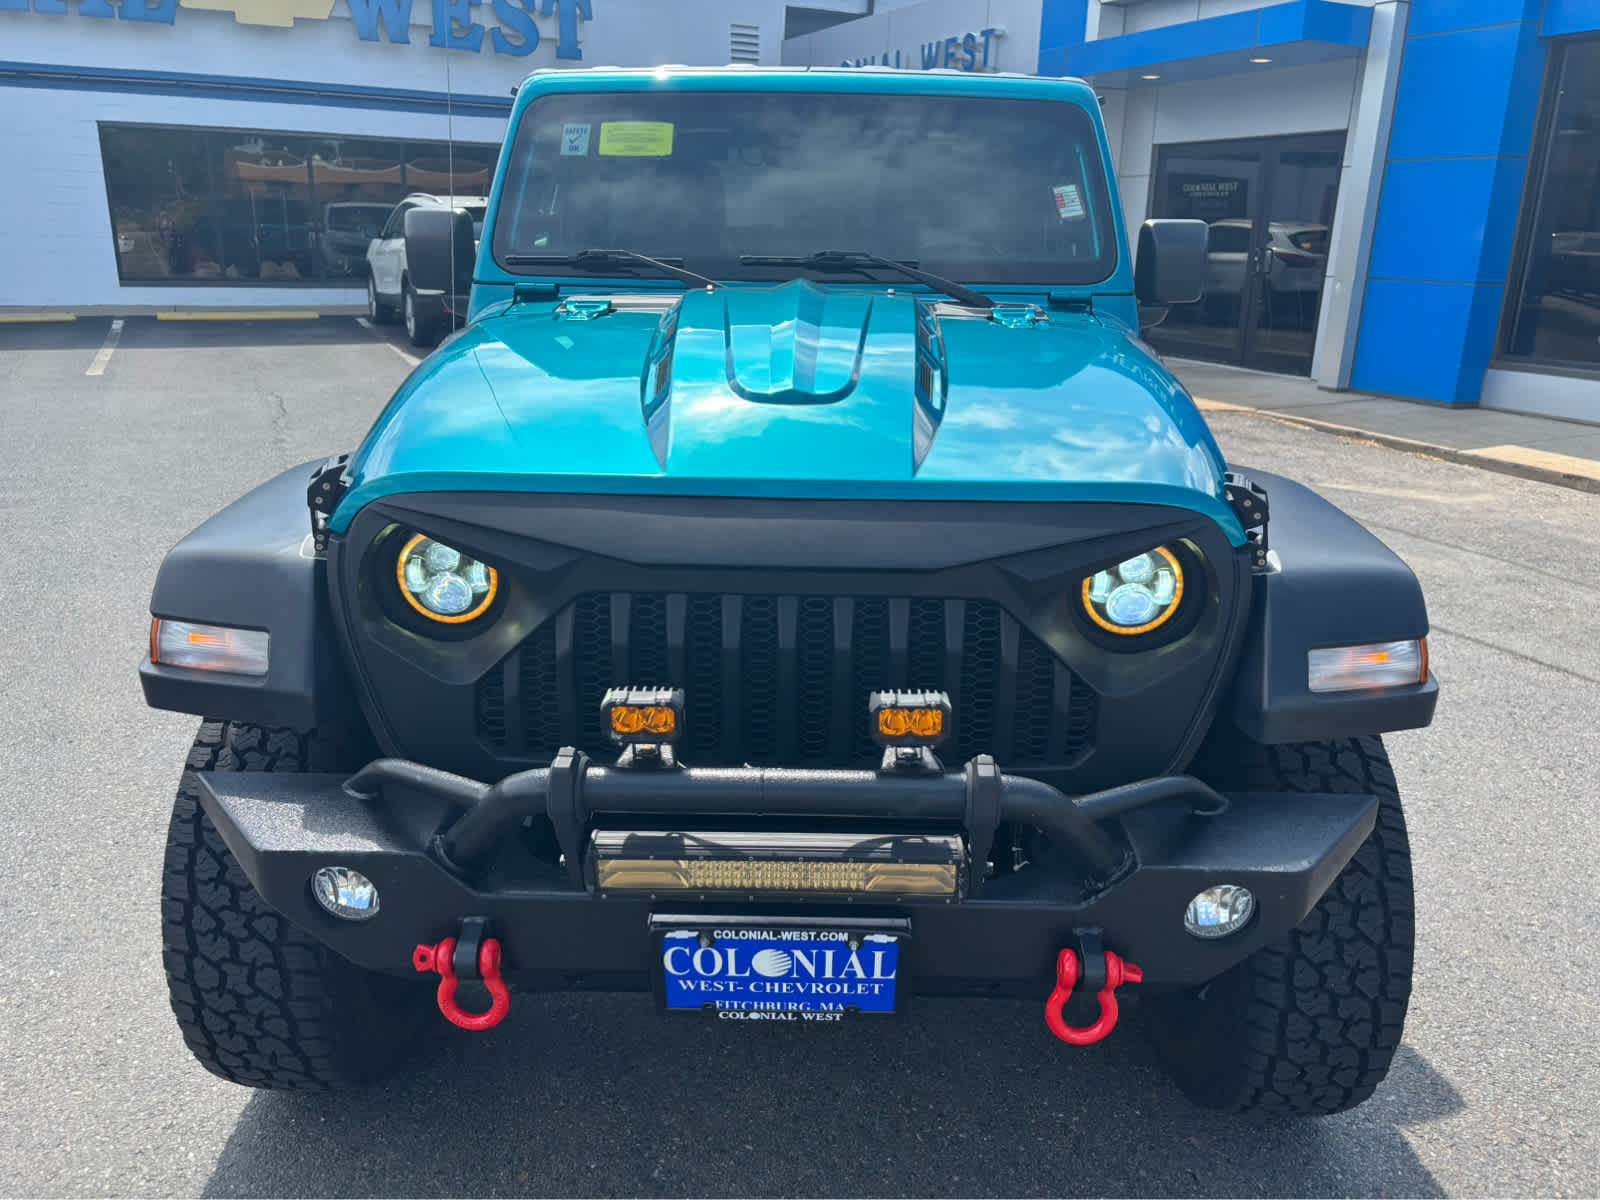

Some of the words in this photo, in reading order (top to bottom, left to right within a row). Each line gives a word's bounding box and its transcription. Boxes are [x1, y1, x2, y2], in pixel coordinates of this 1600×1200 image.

[349, 0, 592, 60] WEST
[921, 27, 998, 72] WEST
[713, 930, 848, 942] COLONIAL-WEST.COM
[663, 946, 896, 980] COLONIAL
[749, 981, 884, 995] CHEVROLET
[819, 1002, 845, 1011] MA
[802, 1012, 843, 1021] WEST
